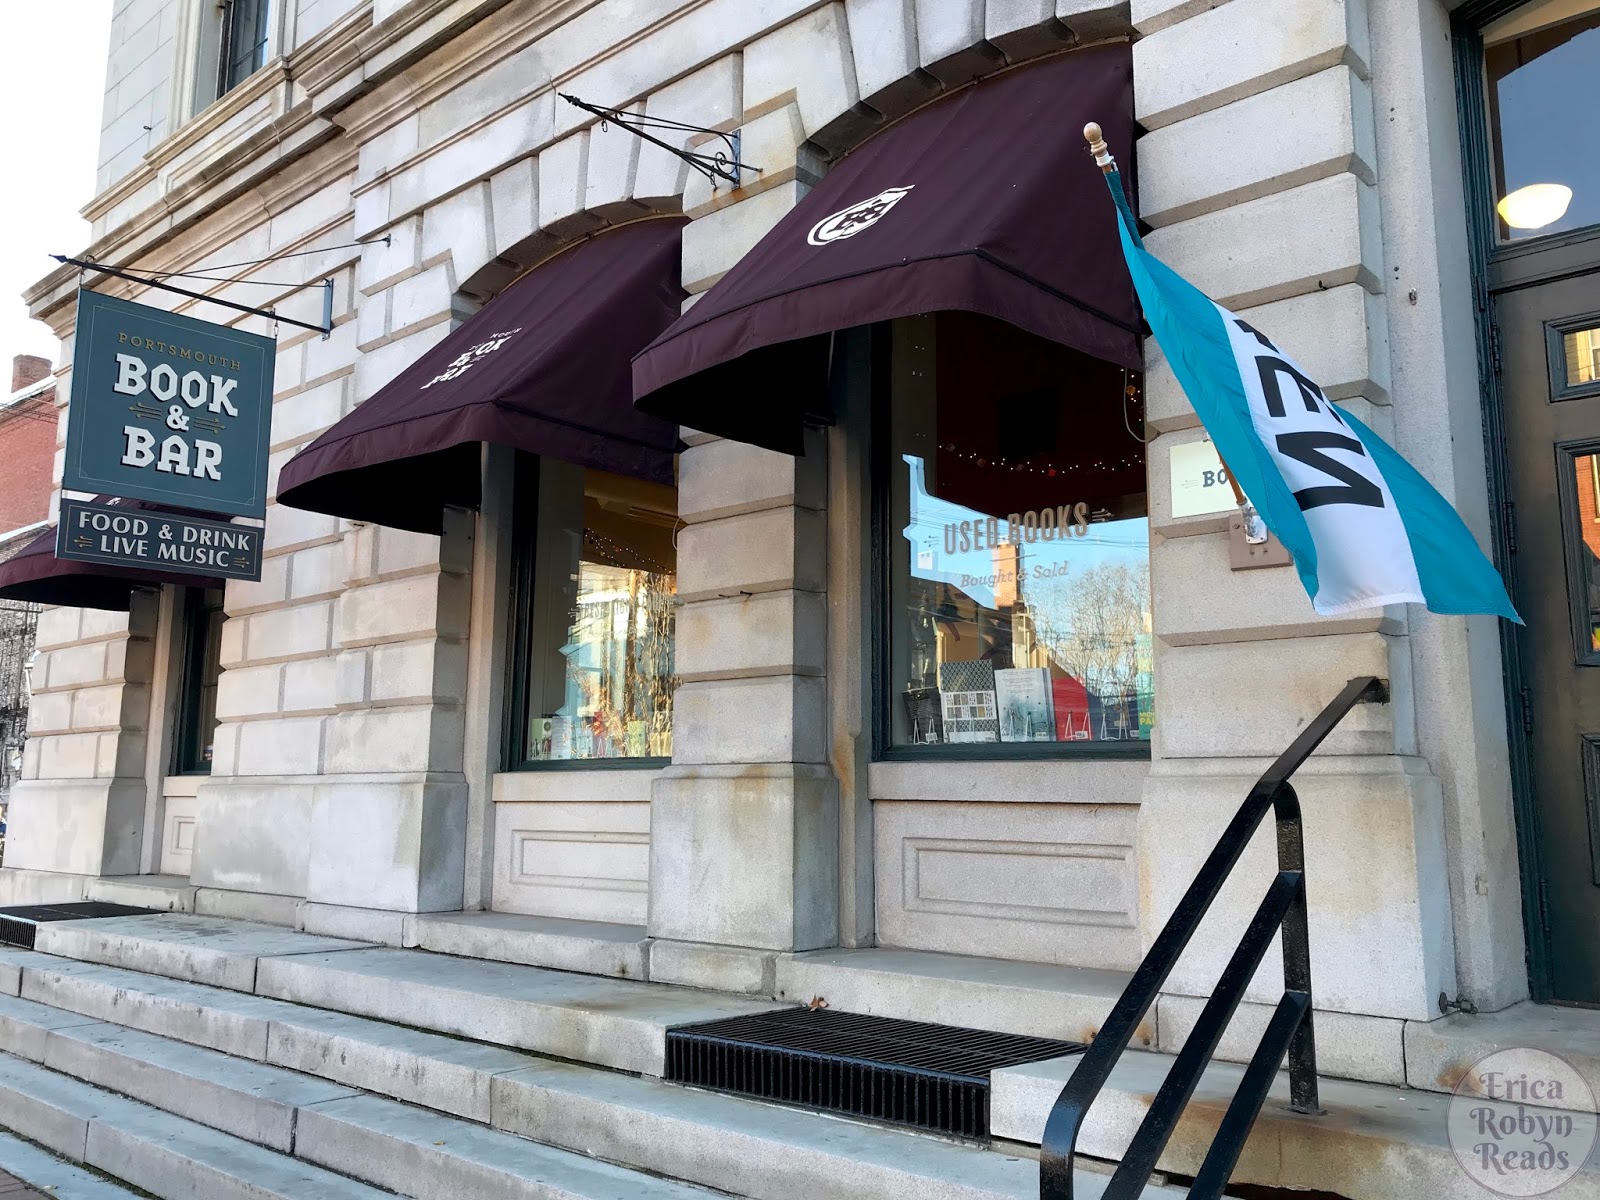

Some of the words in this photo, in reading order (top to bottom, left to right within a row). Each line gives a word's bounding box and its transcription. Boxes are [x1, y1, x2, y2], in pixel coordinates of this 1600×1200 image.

[117, 332, 241, 371] PORTSMOUTH
[114, 353, 239, 417] BOOK
[166, 404, 190, 431] &
[121, 425, 223, 481] BAR
[78, 511, 149, 536] FOOD
[158, 524, 173, 540] &
[182, 526, 250, 551] DRINK
[944, 516, 999, 555] USED
[1006, 502, 1090, 546] BOOKS
[101, 535, 149, 557] LIVE
[157, 544, 230, 568] MUSIC
[960, 568, 1014, 588] Bought
[1033, 560, 1069, 579] Sold
